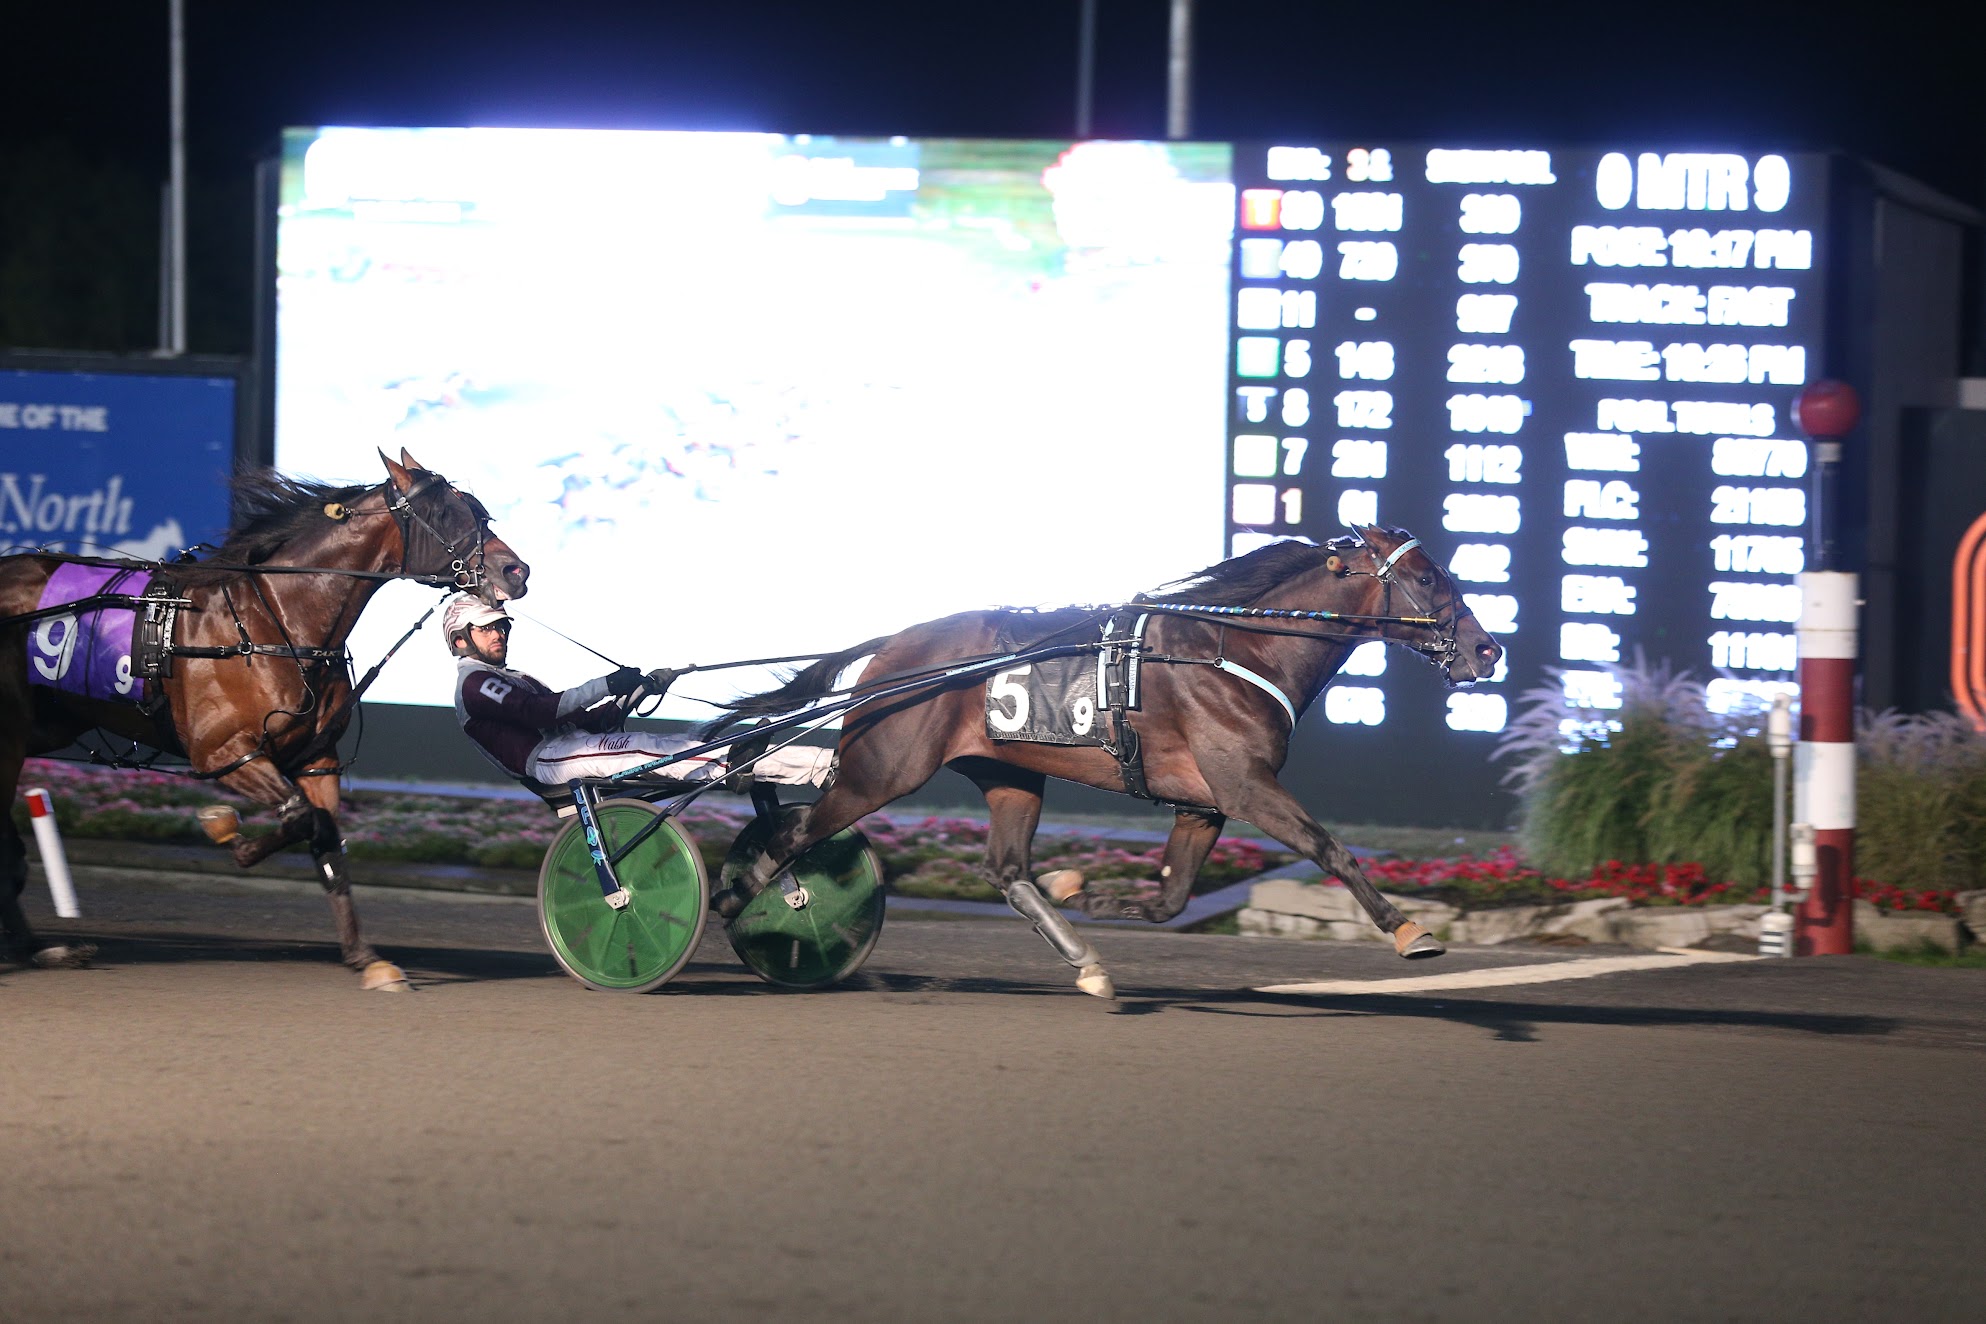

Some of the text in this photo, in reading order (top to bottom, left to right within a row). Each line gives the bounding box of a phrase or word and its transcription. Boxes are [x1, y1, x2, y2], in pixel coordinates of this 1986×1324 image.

[1754, 154, 1790, 211] 9
[22, 404, 55, 429] OF
[60, 405, 108, 432] THE
[1281, 437, 1308, 475] 7
[0, 472, 133, 534] North
[33, 609, 79, 681] 9
[115, 654, 136, 695] 9
[480, 677, 512, 705] B
[989, 663, 1032, 732] 5
[1072, 696, 1094, 735] 9
[586, 734, 632, 751] Walsh
